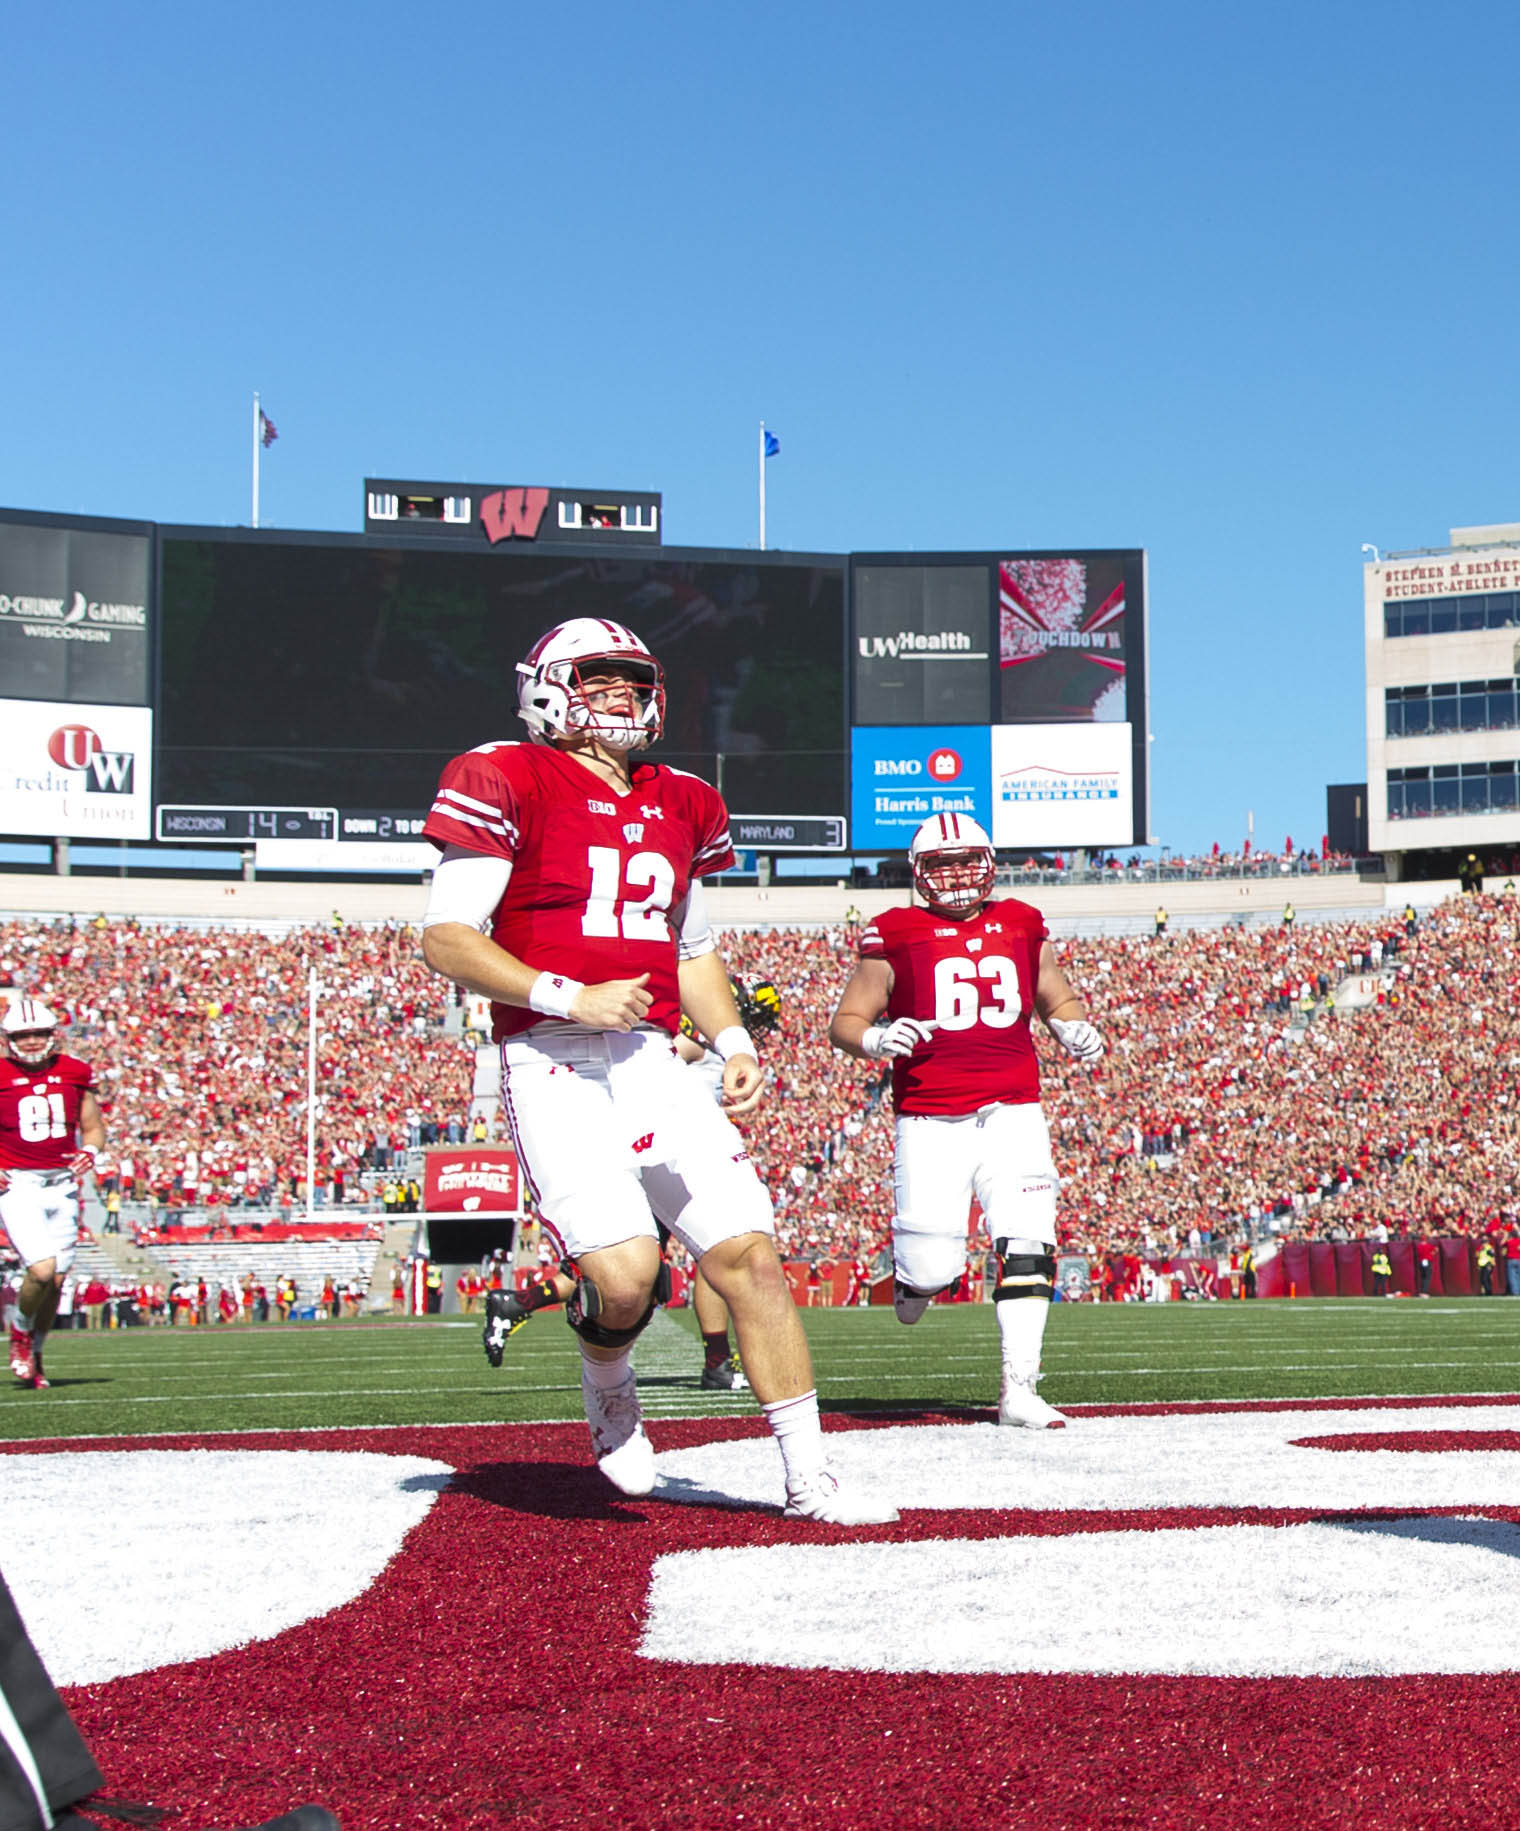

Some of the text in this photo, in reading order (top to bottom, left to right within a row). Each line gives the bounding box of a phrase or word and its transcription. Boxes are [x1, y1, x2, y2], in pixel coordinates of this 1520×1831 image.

[480, 487, 549, 545] W
[1385, 567, 1444, 583] STEPHEN
[1385, 576, 1507, 597] STUDENT-ATHLETE
[87, 602, 147, 625] GAMING
[22, 624, 112, 643] WISCONSIN
[858, 631, 970, 658] UW Health
[874, 759, 922, 776] BMO
[8, 770, 69, 792] redit
[1002, 778, 1119, 789] AMERICAN FAMILY
[875, 795, 976, 812] Harris Bank
[165, 815, 227, 832] WISCONSIN
[248, 812, 278, 837] 14
[379, 815, 393, 837] 2
[394, 819, 410, 834] TO
[622, 823, 645, 845] W
[740, 820, 841, 847] MARYLAND 3
[581, 846, 675, 943] 12
[934, 955, 1022, 1031] 63
[18, 1093, 67, 1143] 81
[631, 1132, 655, 1154] W
